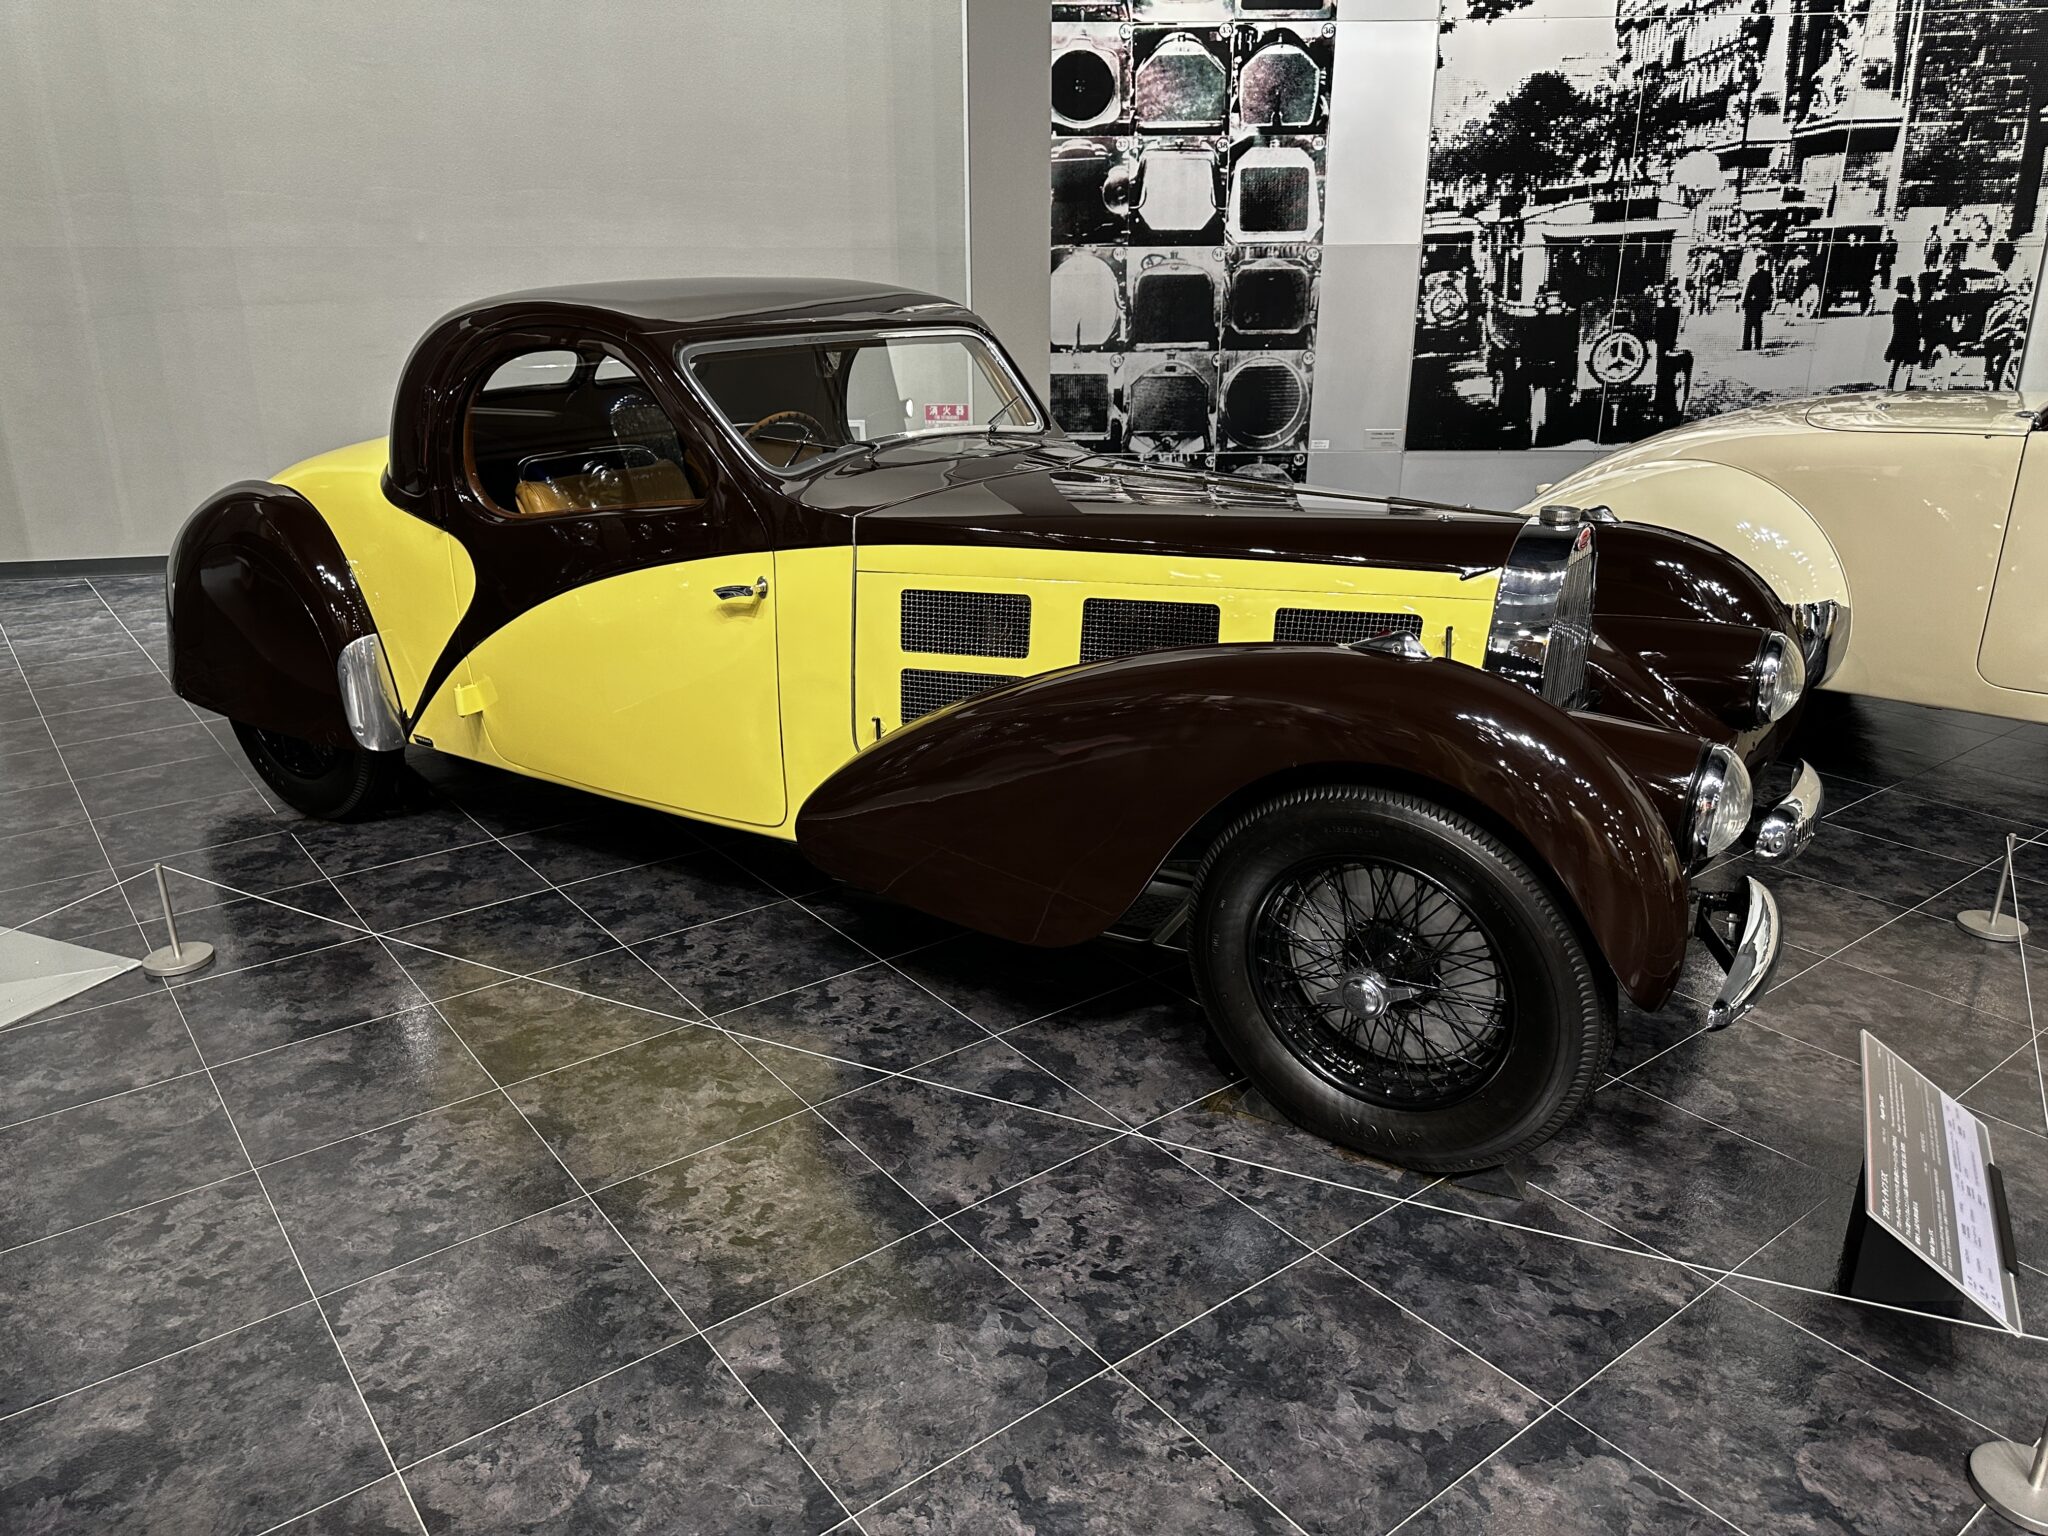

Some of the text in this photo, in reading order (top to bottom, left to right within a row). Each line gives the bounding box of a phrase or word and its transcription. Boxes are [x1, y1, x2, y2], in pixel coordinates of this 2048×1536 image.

[1323, 26, 1334, 35] 36
[1217, 141, 1228, 149] 38
[929, 404, 964, 416] 消火器
